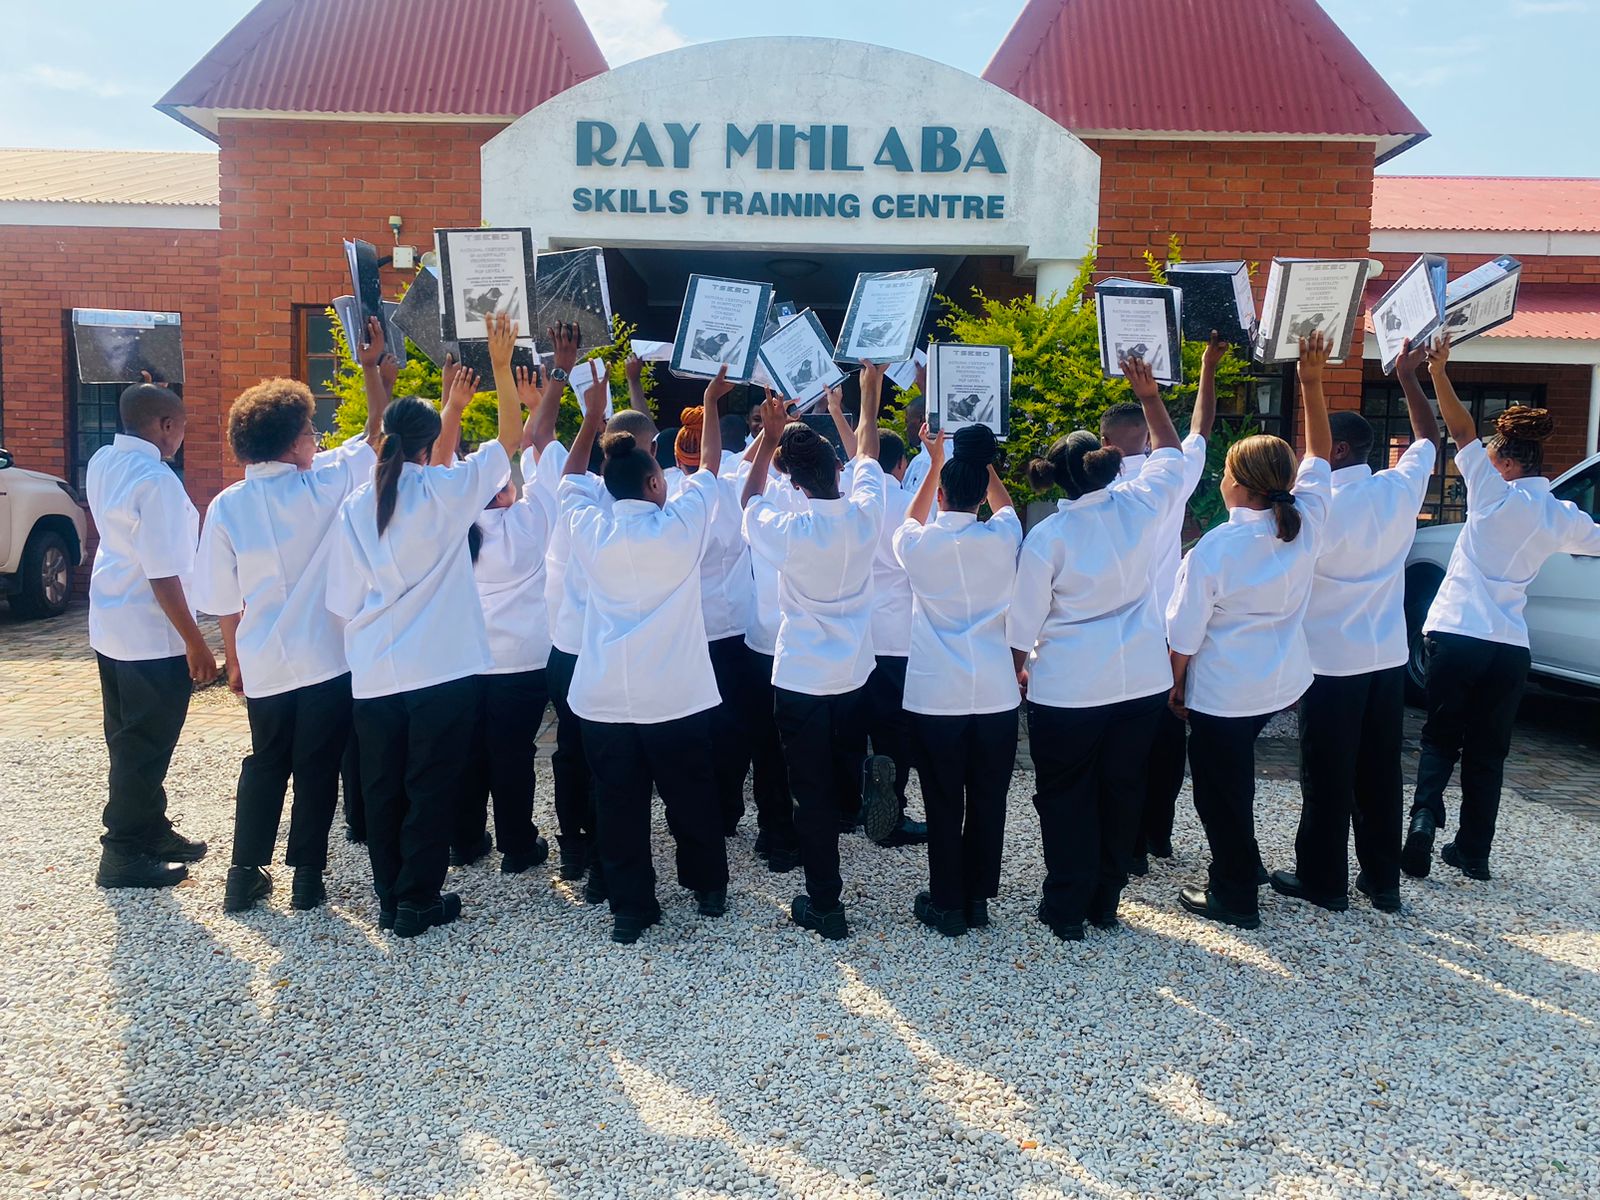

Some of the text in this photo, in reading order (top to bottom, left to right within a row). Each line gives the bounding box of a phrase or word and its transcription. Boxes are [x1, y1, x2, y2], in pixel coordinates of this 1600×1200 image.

[576, 121, 1007, 173] RAY MHLABA
[573, 187, 1005, 219] SKILLS TRAINING CENTRE
